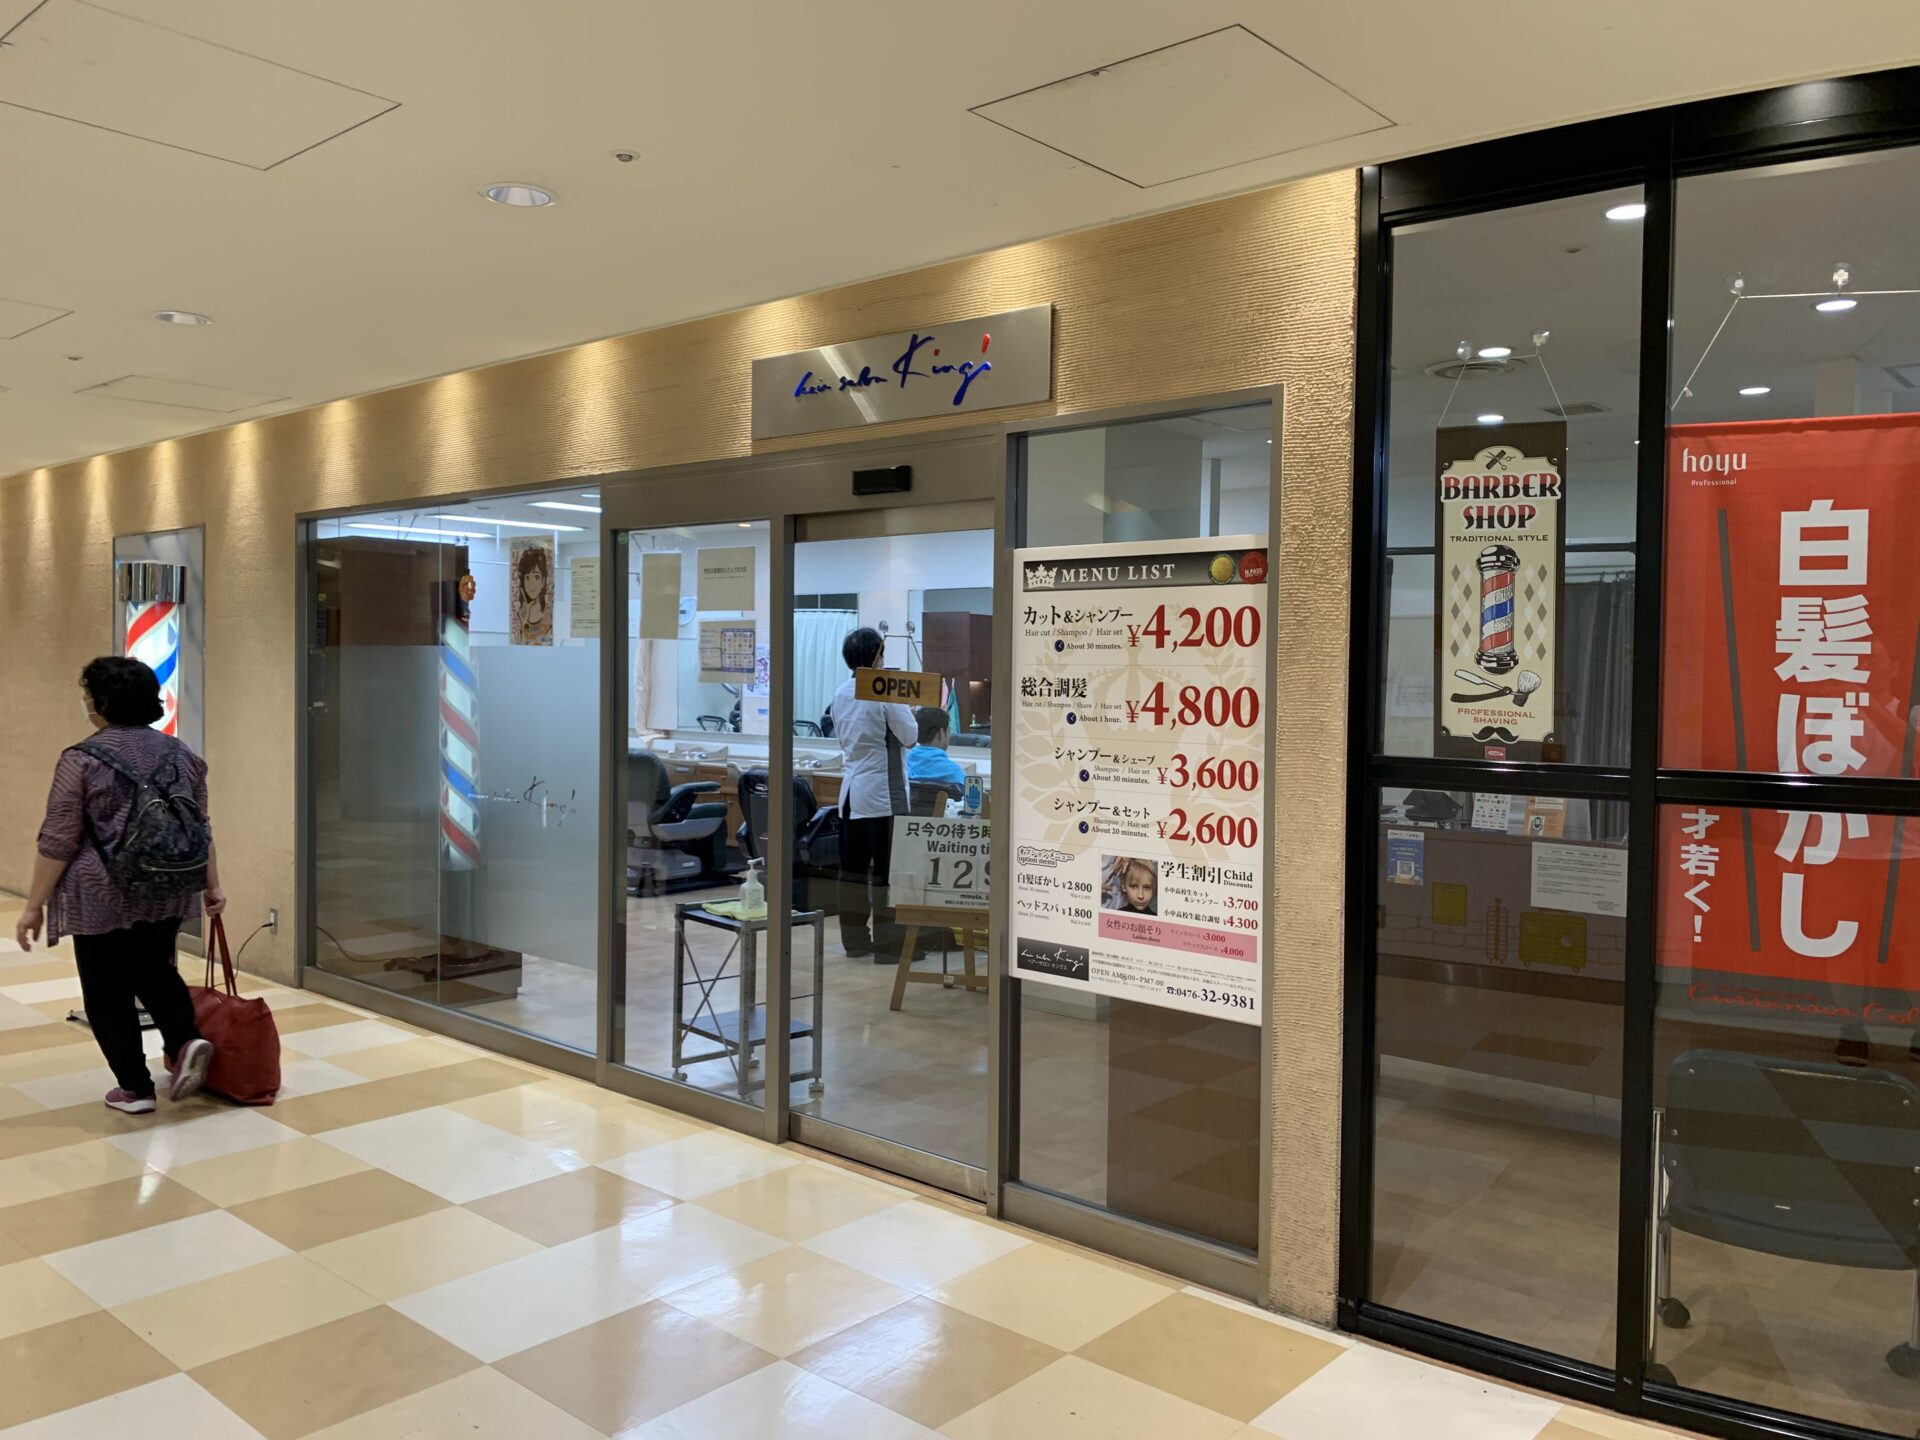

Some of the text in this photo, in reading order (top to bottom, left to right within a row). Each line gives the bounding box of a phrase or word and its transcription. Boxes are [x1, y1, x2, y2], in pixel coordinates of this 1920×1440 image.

[838, 366, 888, 392] salon
[1682, 447, 1747, 476] hoyu
[1443, 473, 1559, 500] BARBER
[1691, 478, 1737, 487] Professional
[1463, 504, 1536, 529] SHOP
[1060, 563, 1175, 584] MENU LIST
[1023, 605, 1133, 625] カット&シャンプー
[1025, 629, 1039, 637] Hair
[1040, 629, 1051, 637] cut
[1057, 628, 1088, 638] Shampoo
[1096, 628, 1112, 636] Hair
[1127, 604, 1261, 653] ¥4,200
[872, 676, 921, 699] OPEN
[1020, 677, 1088, 699] 総合調髪
[1047, 701, 1072, 709] Shampoo
[1125, 681, 1260, 730] ¥4,800
[1457, 708, 1535, 719] PROFESSIONAL
[1473, 716, 1518, 725] SHAVING
[1094, 765, 1120, 774] Shampoo
[1157, 753, 1259, 791] ¥3,600
[1121, 776, 1150, 784] minutes.
[1054, 798, 1150, 819] シャンプー&セット
[1093, 817, 1119, 826] Shampoo
[1156, 808, 1258, 848] ¥2,600
[1091, 826, 1110, 834] About
[1121, 829, 1149, 838] minutes.
[927, 840, 977, 856] Waiting
[1161, 861, 1221, 884] 学生割引
[1224, 870, 1253, 882] Child
[1017, 873, 1060, 888] 白髪ぼかし
[1062, 881, 1092, 893] ¥2,800
[1223, 880, 1253, 889] Discounts
[1223, 896, 1258, 911] ¥3,700
[1062, 907, 1092, 919] ¥1,800
[1106, 918, 1162, 936] 女性のお顔そり
[1223, 915, 1258, 930] ¥4,300
[1091, 967, 1110, 976] OPEN
